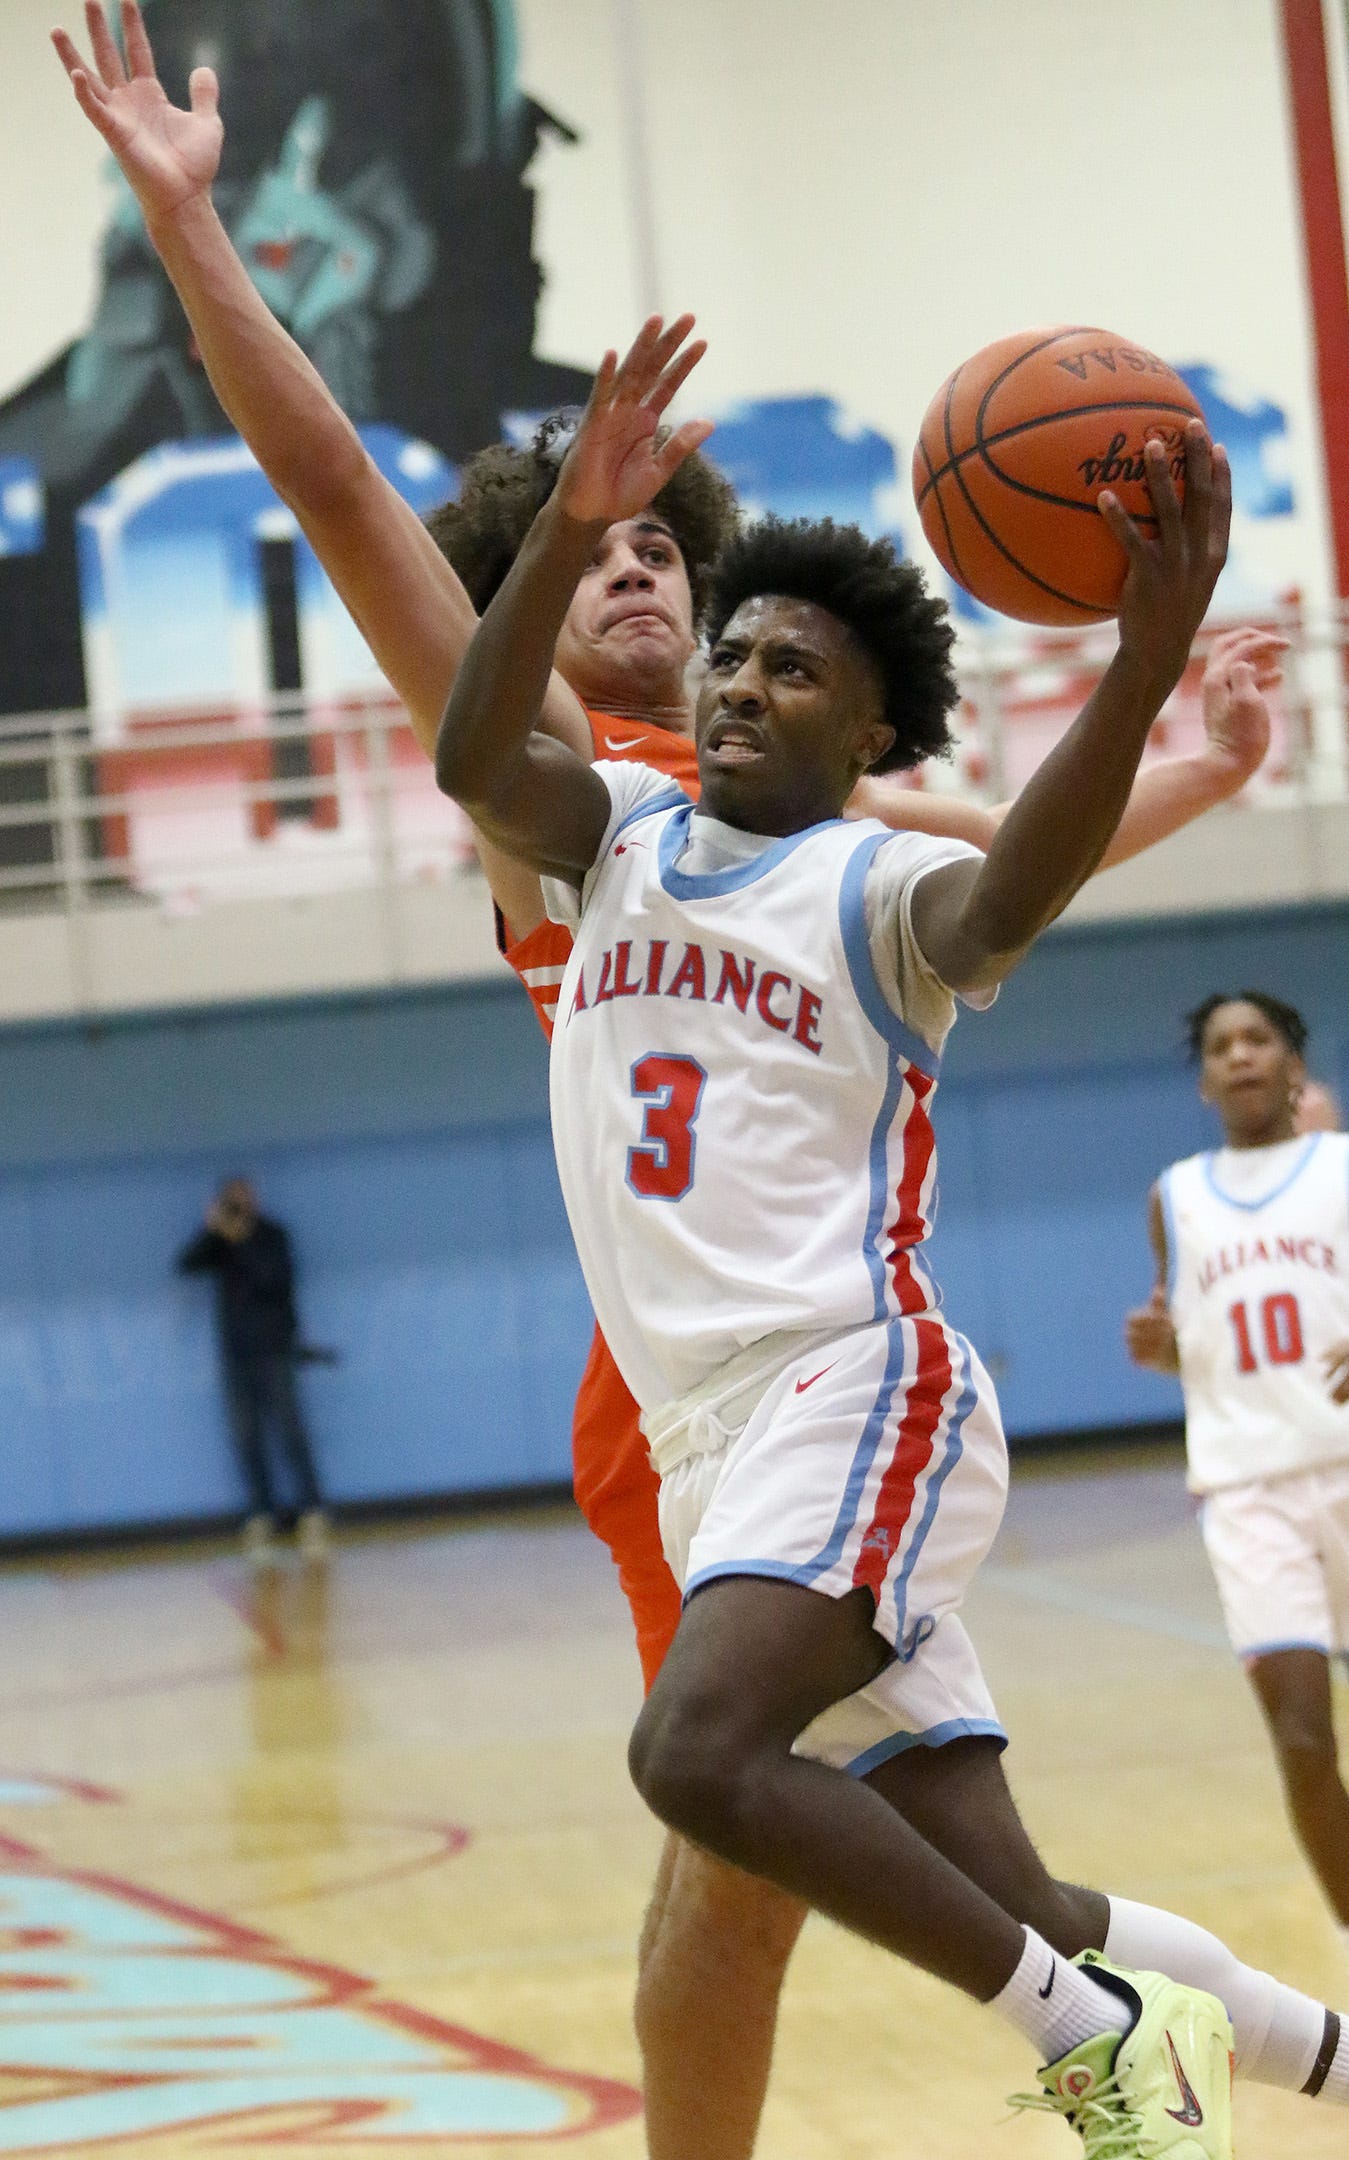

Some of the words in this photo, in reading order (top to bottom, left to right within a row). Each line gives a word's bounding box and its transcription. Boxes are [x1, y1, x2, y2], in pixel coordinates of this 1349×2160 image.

[566, 939, 823, 1056] ALLIANCE
[624, 1050, 708, 1203] 3
[1228, 1293, 1304, 1374] 10
